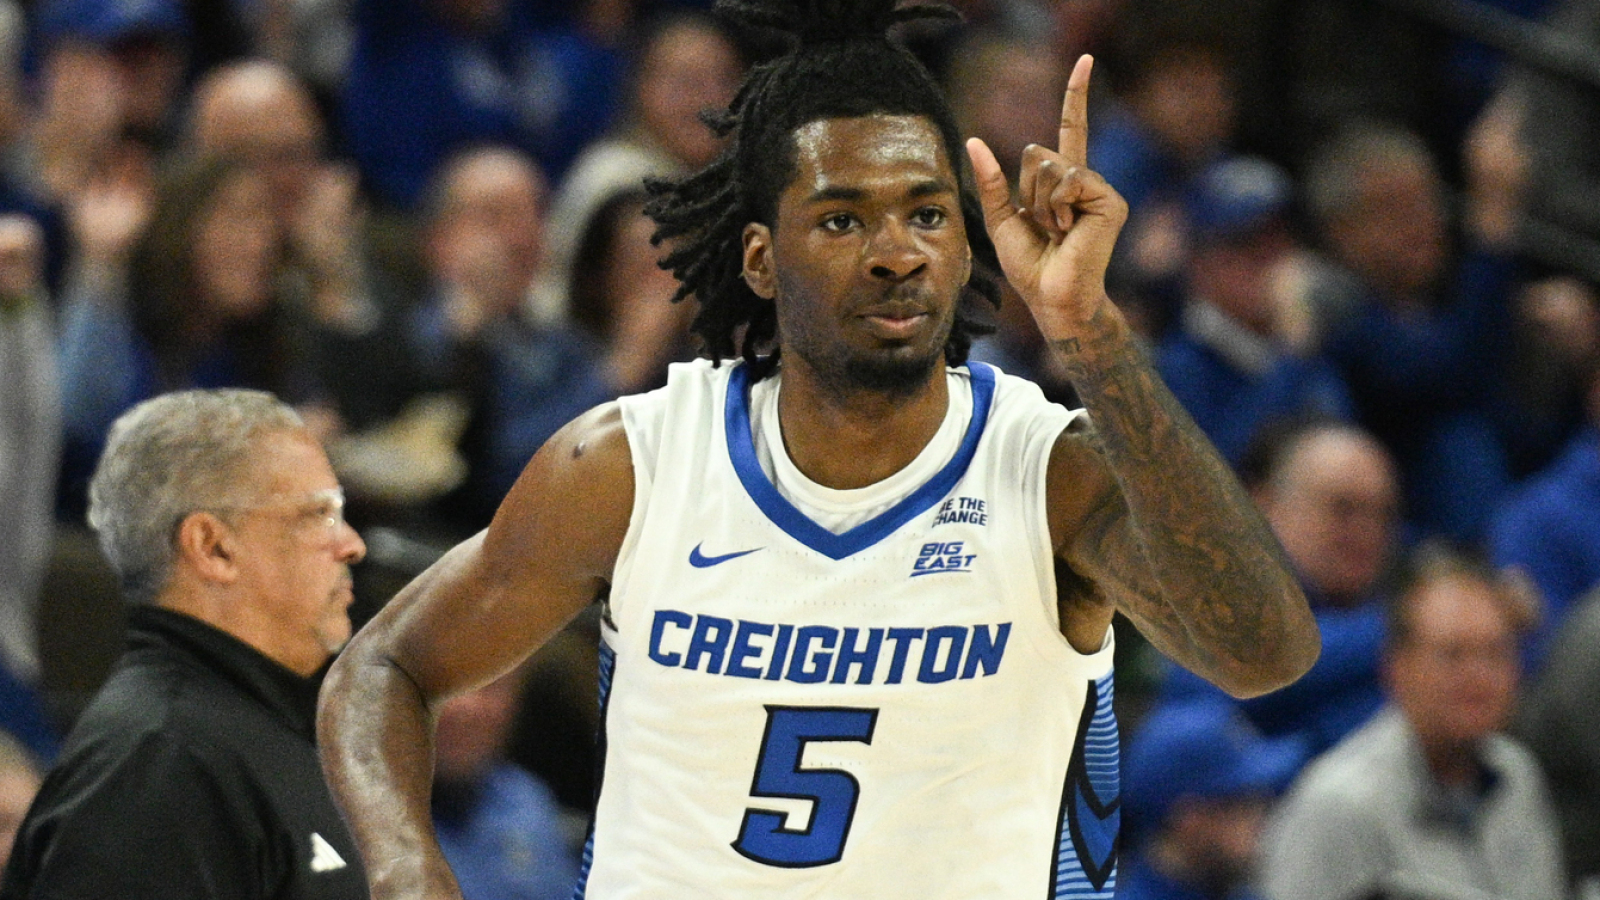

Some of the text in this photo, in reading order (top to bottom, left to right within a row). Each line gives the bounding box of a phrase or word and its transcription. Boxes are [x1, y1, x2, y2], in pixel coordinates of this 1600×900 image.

[959, 497, 986, 512] THE
[919, 541, 964, 556] BIG
[913, 554, 977, 570] EAST
[648, 609, 1012, 685] CREIGHTON
[730, 704, 880, 868] 5
